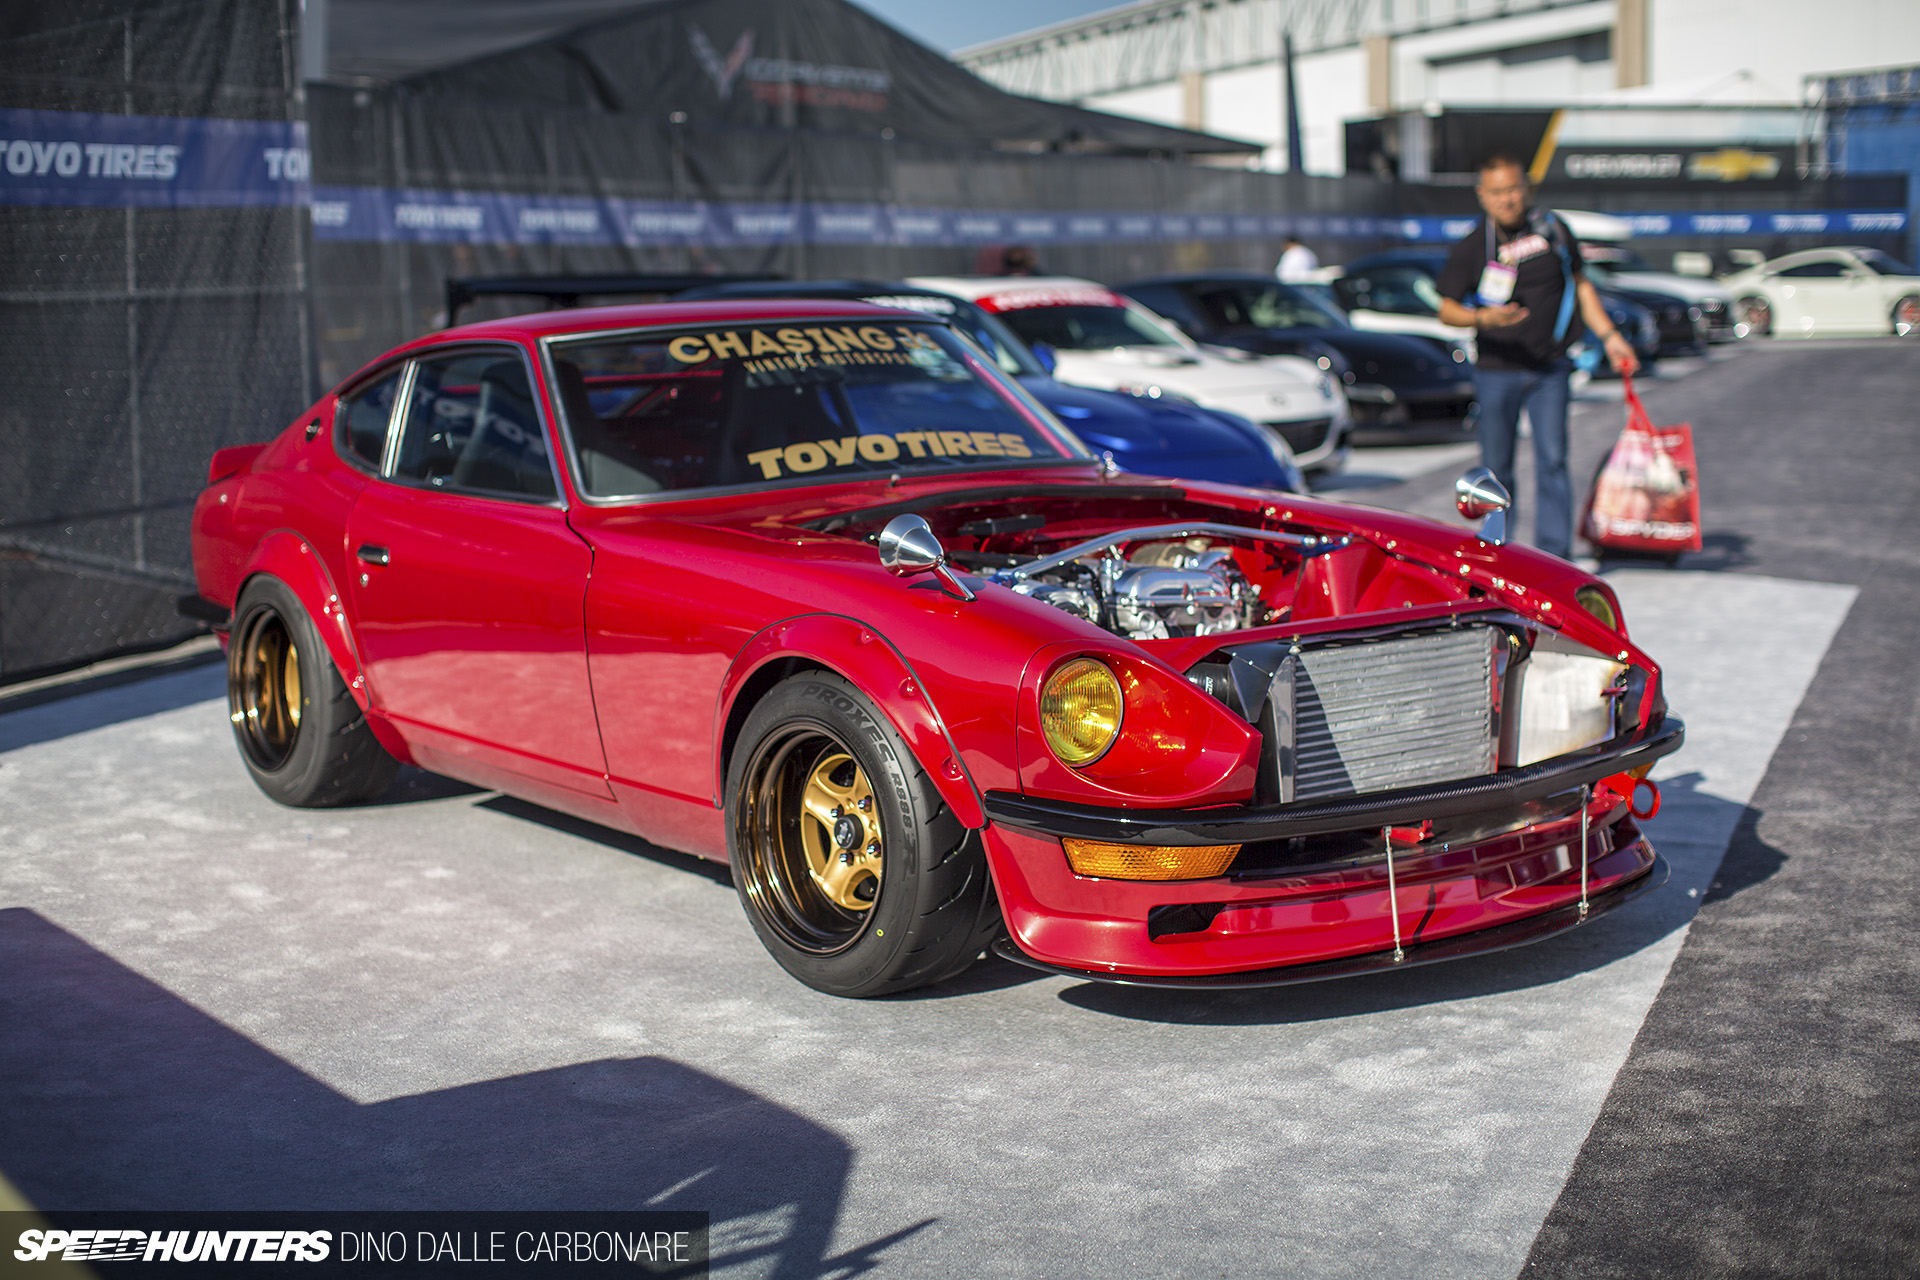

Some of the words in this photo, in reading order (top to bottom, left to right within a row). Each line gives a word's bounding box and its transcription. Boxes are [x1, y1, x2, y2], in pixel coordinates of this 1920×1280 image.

[85, 142, 180, 181] TIRES
[264, 147, 310, 182] TO
[668, 326, 896, 364] CHASING
[743, 350, 818, 375] VINTAGE
[820, 351, 932, 367] MOTORSPOR
[746, 433, 901, 481] TOYO
[895, 430, 1033, 459] TIRES
[801, 684, 896, 763] PROXES
